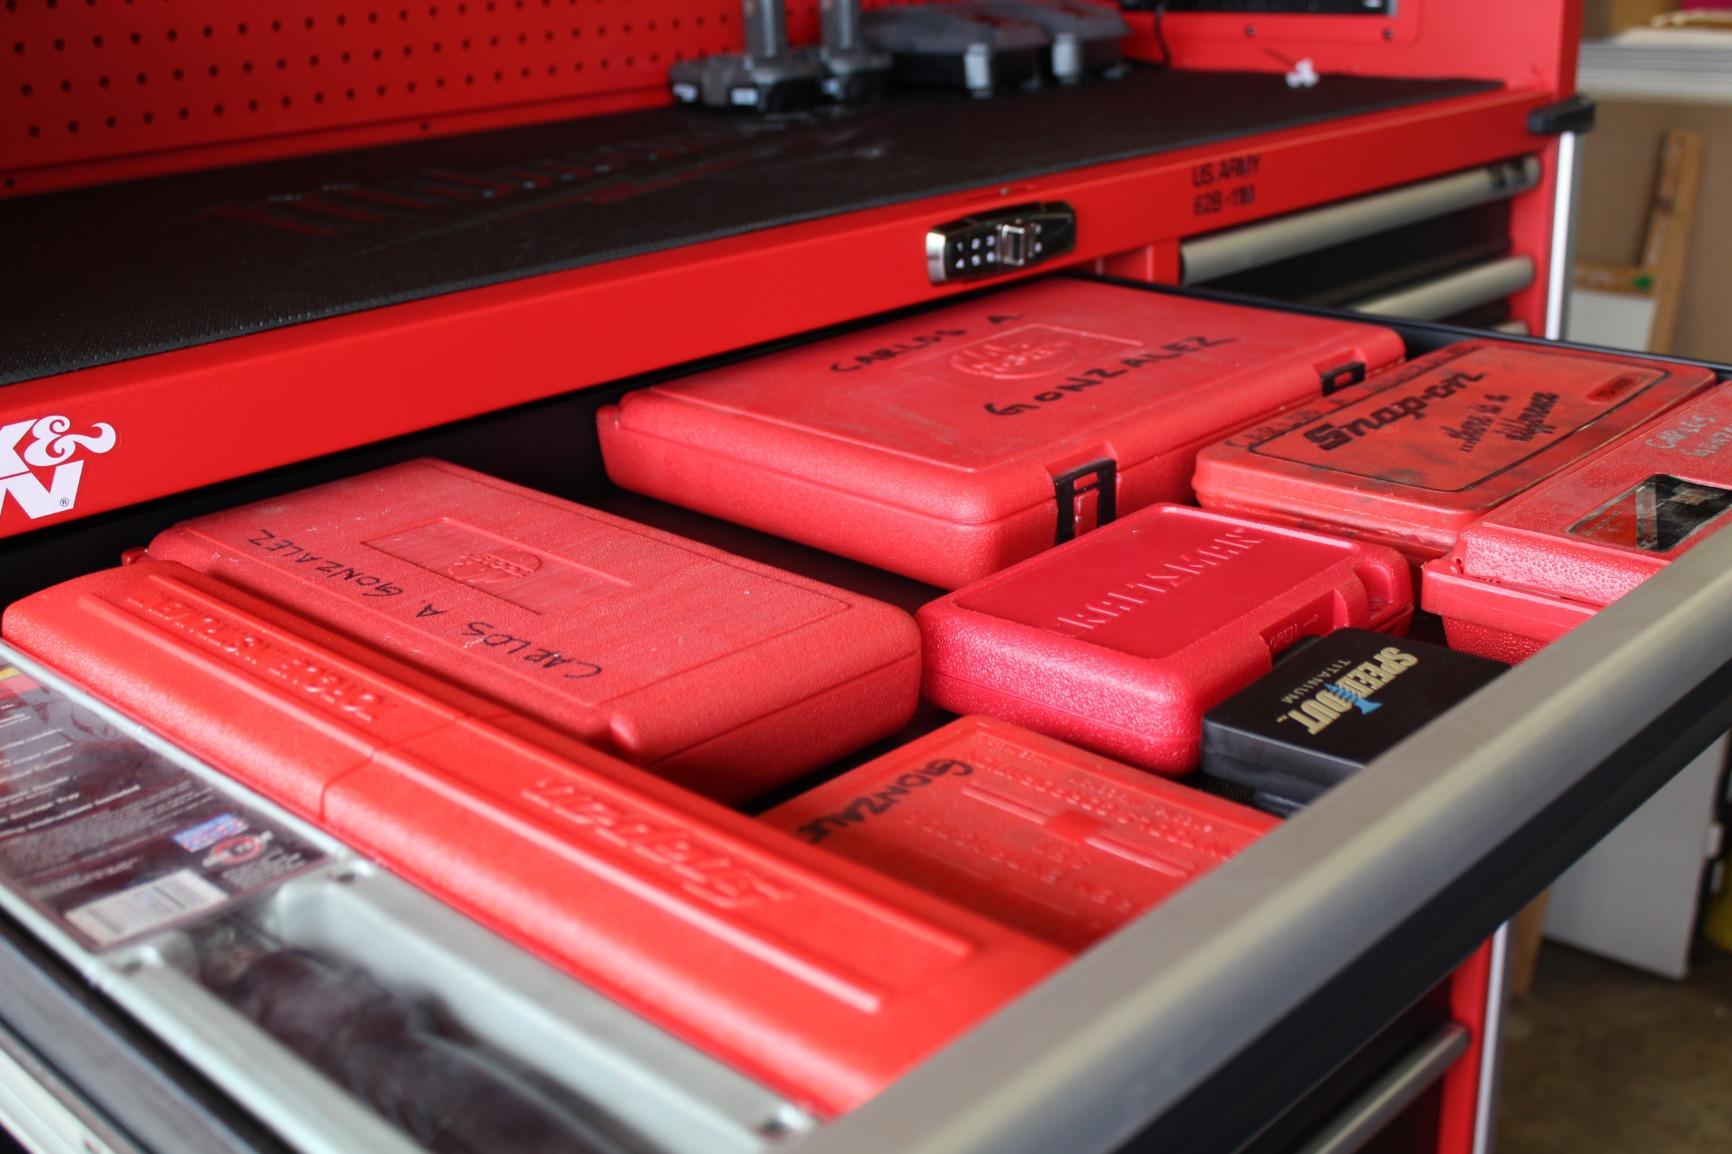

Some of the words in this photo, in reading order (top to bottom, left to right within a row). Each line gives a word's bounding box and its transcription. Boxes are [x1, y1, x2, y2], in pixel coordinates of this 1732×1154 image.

[830, 326, 967, 373] CARLOS
[984, 335, 1238, 416] GONZALEZ
[247, 528, 405, 598] GONZALEZ
[463, 620, 604, 679] CARLOS
[1280, 658, 1352, 705] TITANIUM
